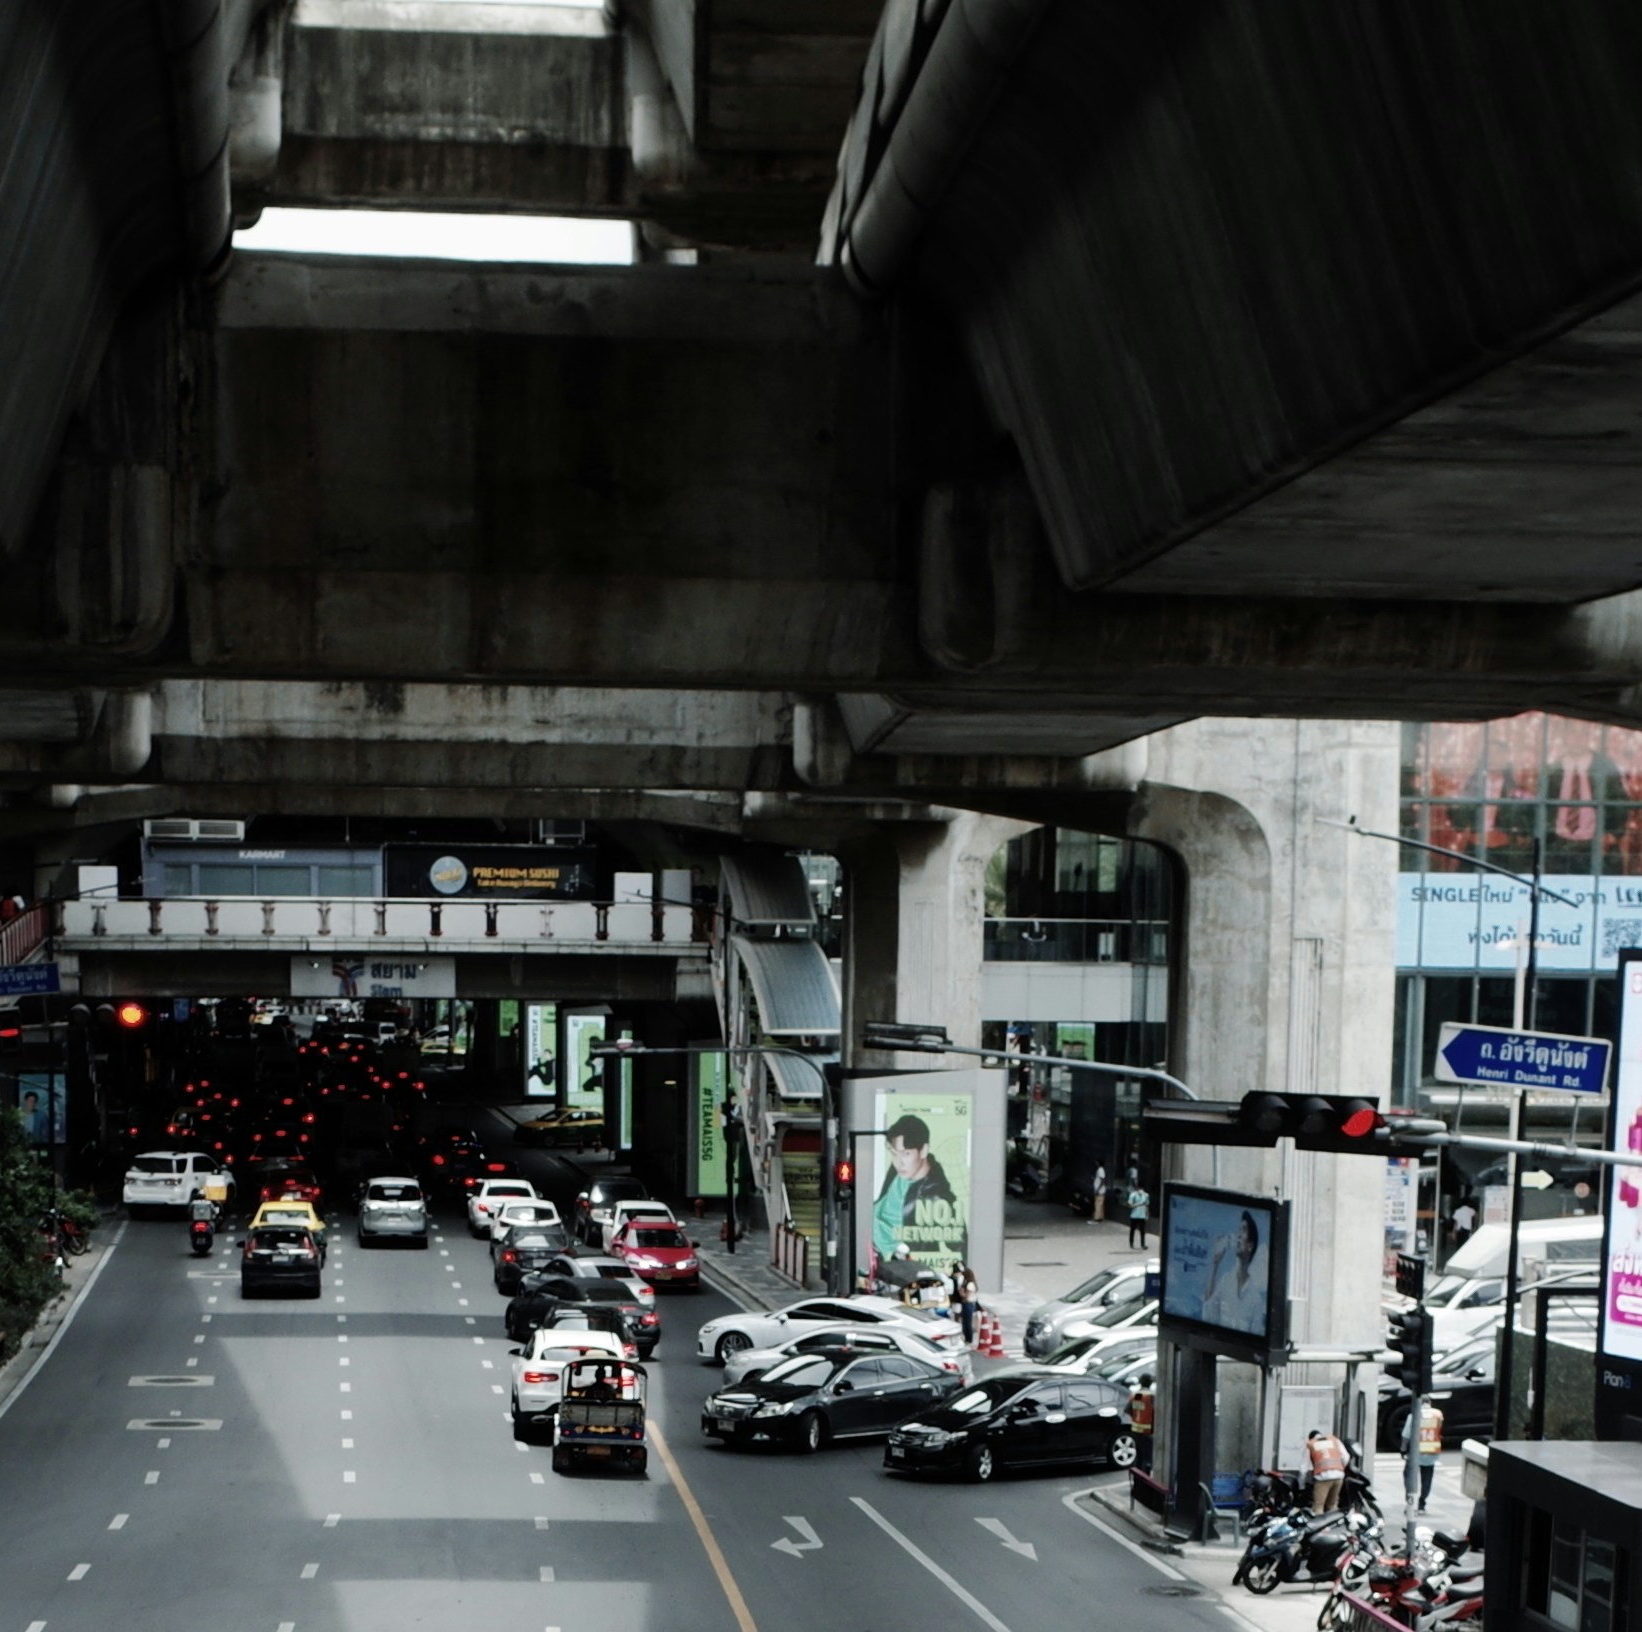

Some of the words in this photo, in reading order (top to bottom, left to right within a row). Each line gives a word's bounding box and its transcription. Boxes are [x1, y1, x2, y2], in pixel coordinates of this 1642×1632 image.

[239, 849, 285, 859] KARMART
[472, 867, 527, 878] PREMIUM
[529, 867, 560, 878] SUSHI
[1411, 886, 1480, 903] SINGLE
[371, 962, 416, 979] สยาม
[371, 984, 402, 997] Siam
[1500, 1036, 1592, 1073] อังรีดูนังต์
[1476, 1066, 1509, 1080] Henri
[1514, 1069, 1557, 1085] Dunant
[1562, 1074, 1582, 1088] Rd.
[955, 1105, 967, 1116] 5G
[702, 1087, 713, 1161] #TEAMAIS5G
[915, 1199, 965, 1227] NO.1
[893, 1226, 965, 1242] NETWORK
